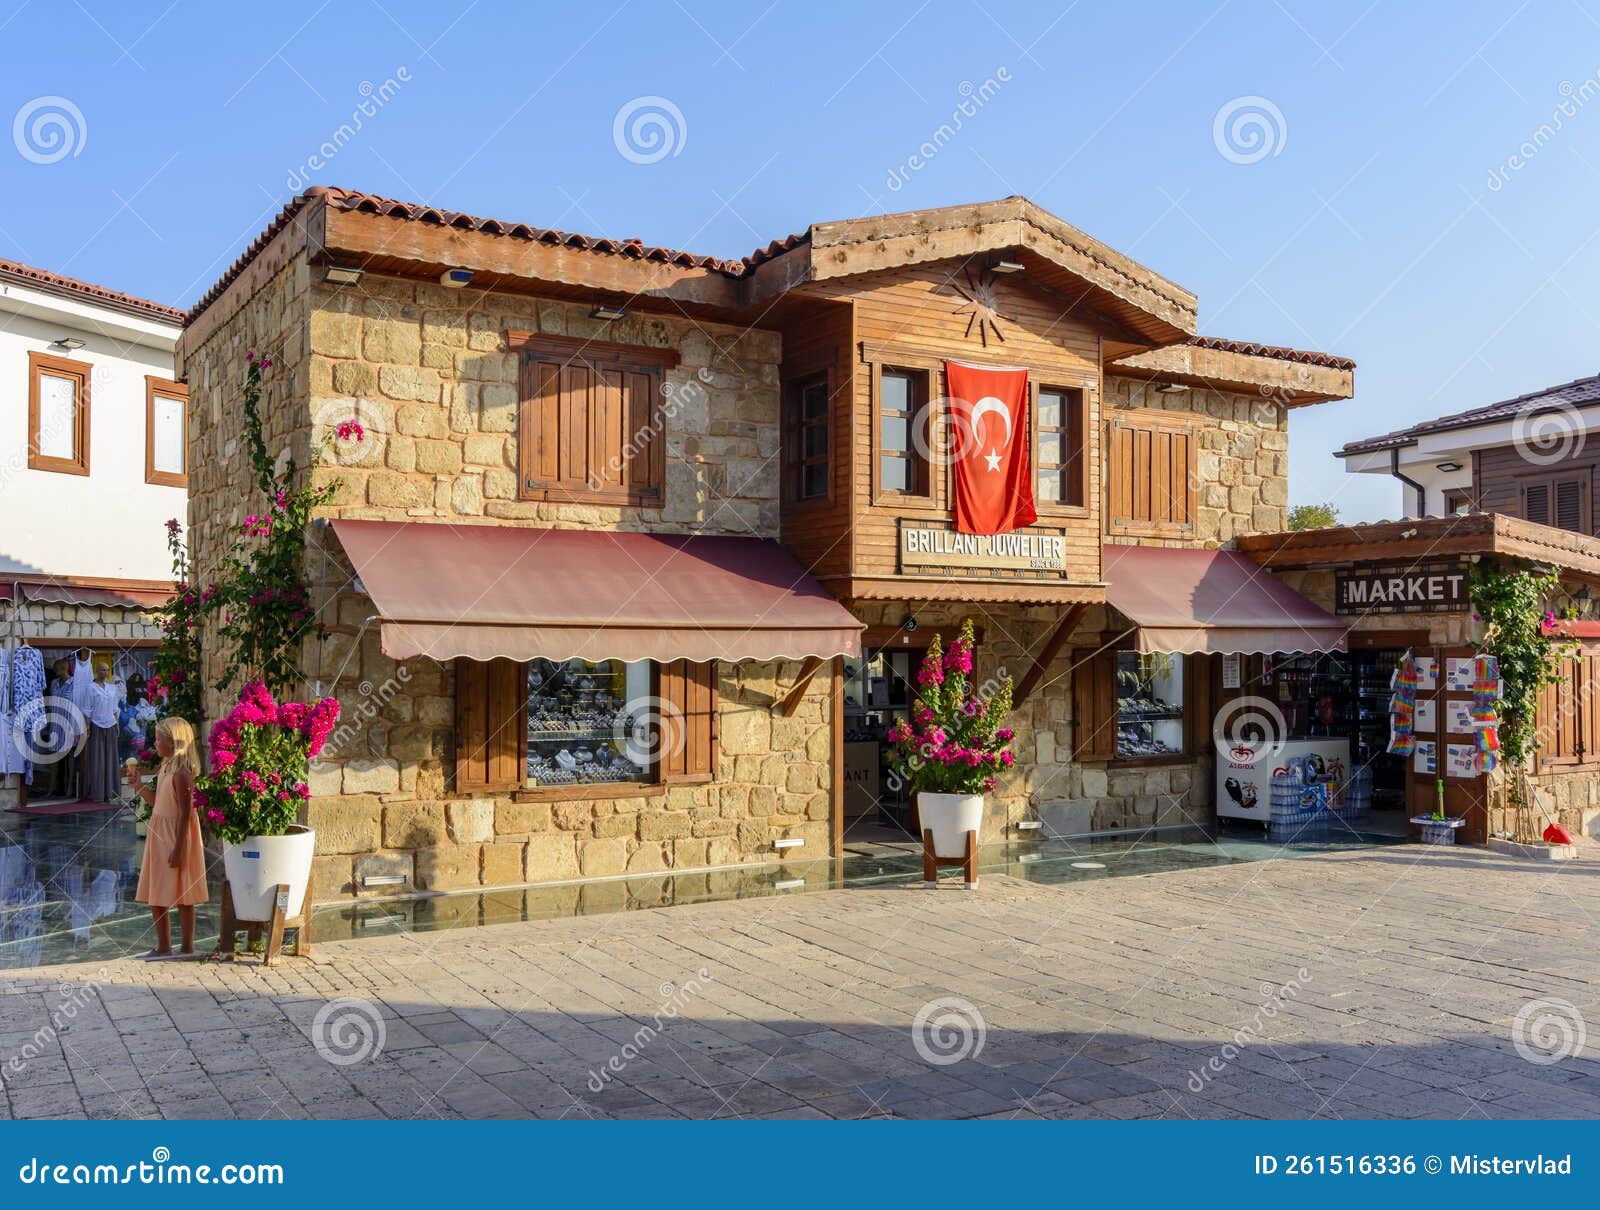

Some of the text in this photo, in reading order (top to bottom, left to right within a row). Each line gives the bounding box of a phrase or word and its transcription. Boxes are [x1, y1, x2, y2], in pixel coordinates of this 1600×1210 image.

[906, 529, 1061, 559] BRILLANT JUWELIER
[1348, 575, 1464, 603] MARKET
